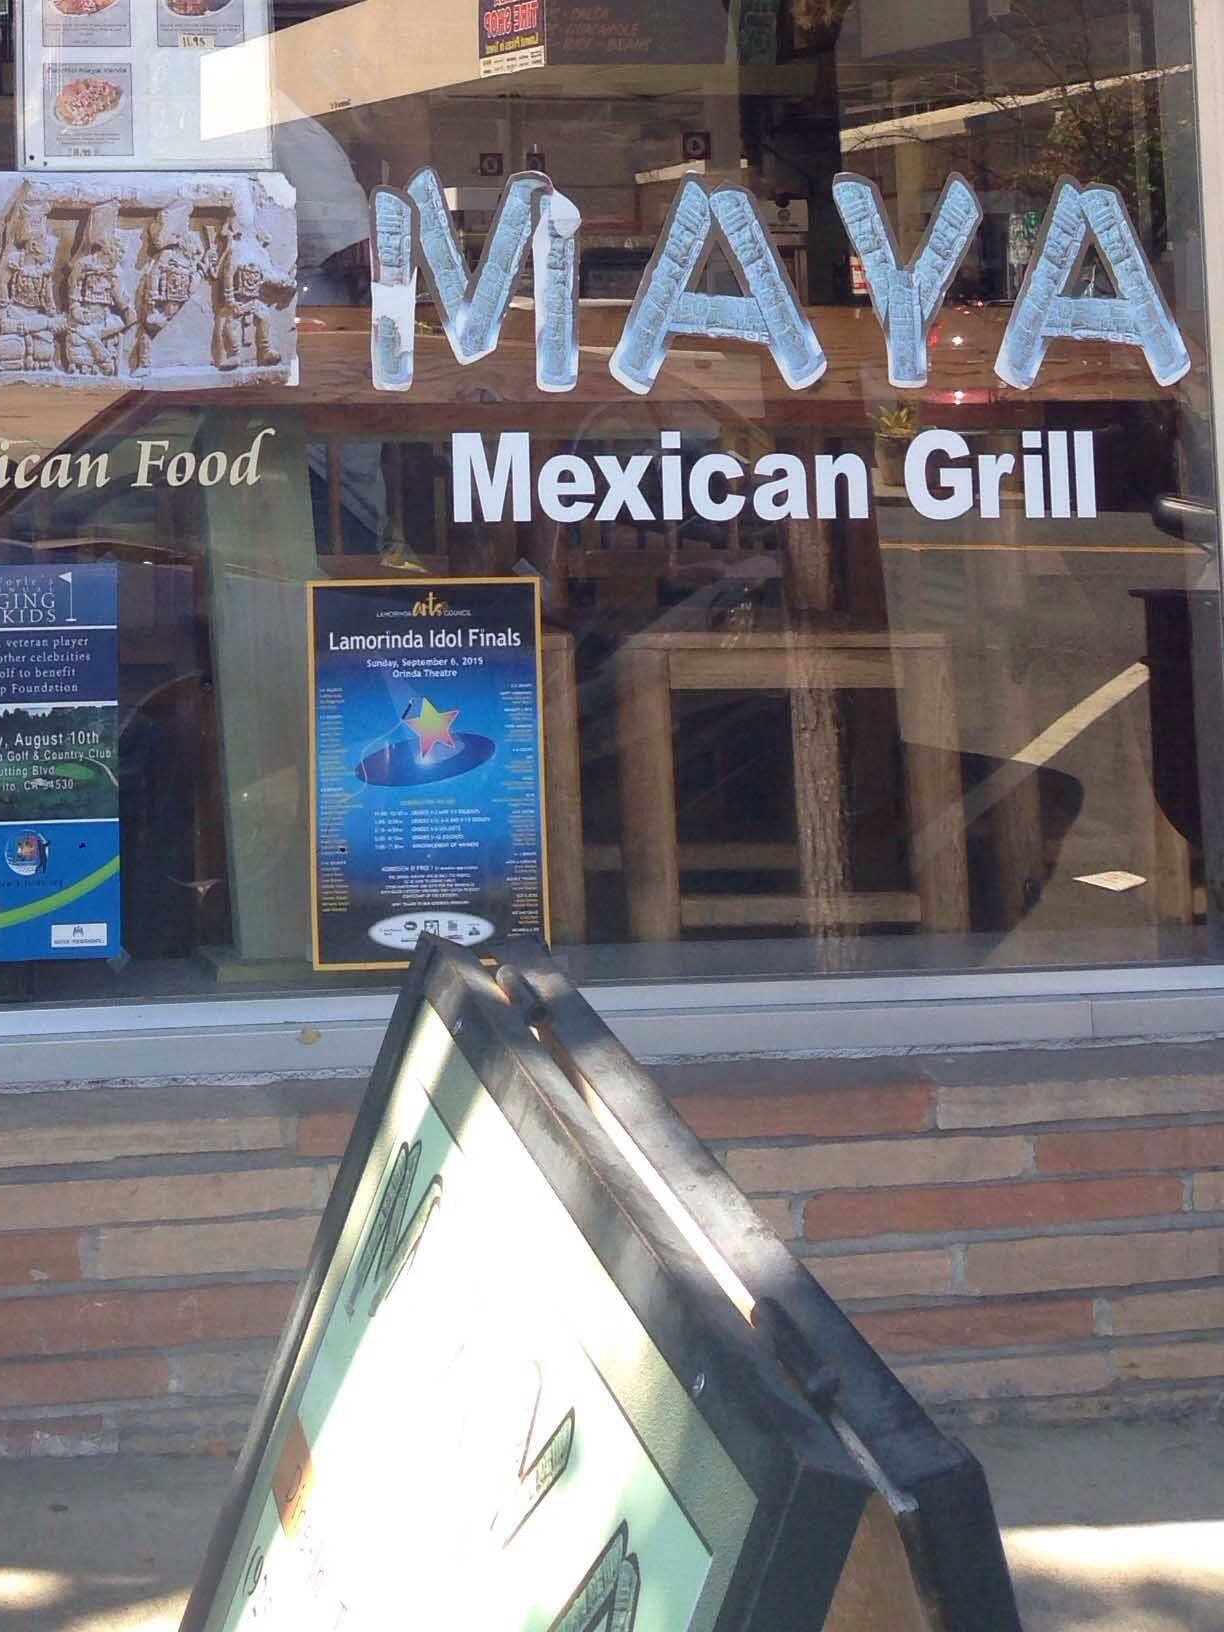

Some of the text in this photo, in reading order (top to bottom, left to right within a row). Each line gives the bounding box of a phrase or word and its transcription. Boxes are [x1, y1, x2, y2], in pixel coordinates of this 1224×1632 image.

[369, 166, 1193, 397] MAYA
[130, 427, 276, 488] Food
[451, 428, 1098, 523] Mexican Grill
[412, 592, 445, 617] arts
[2, 608, 57, 624] KIDS
[6, 637, 50, 649] veteran
[53, 635, 89, 649] player
[329, 627, 522, 651] Lamorinda Idol Finals
[30, 651, 91, 663] celebrities
[366, 658, 400, 670] Sunday,
[401, 657, 448, 669] September
[462, 656, 484, 666] 2015
[19, 669, 31, 678] to
[35, 667, 76, 678] benefit
[392, 668, 458, 679] Orinda Theatre
[11, 682, 79, 694] Foundation
[14, 732, 64, 747] August
[68, 732, 100, 745] 10th
[7, 750, 30, 762] Golf
[33, 750, 40, 760] &
[43, 749, 84, 762] Country
[87, 748, 112, 759] Club
